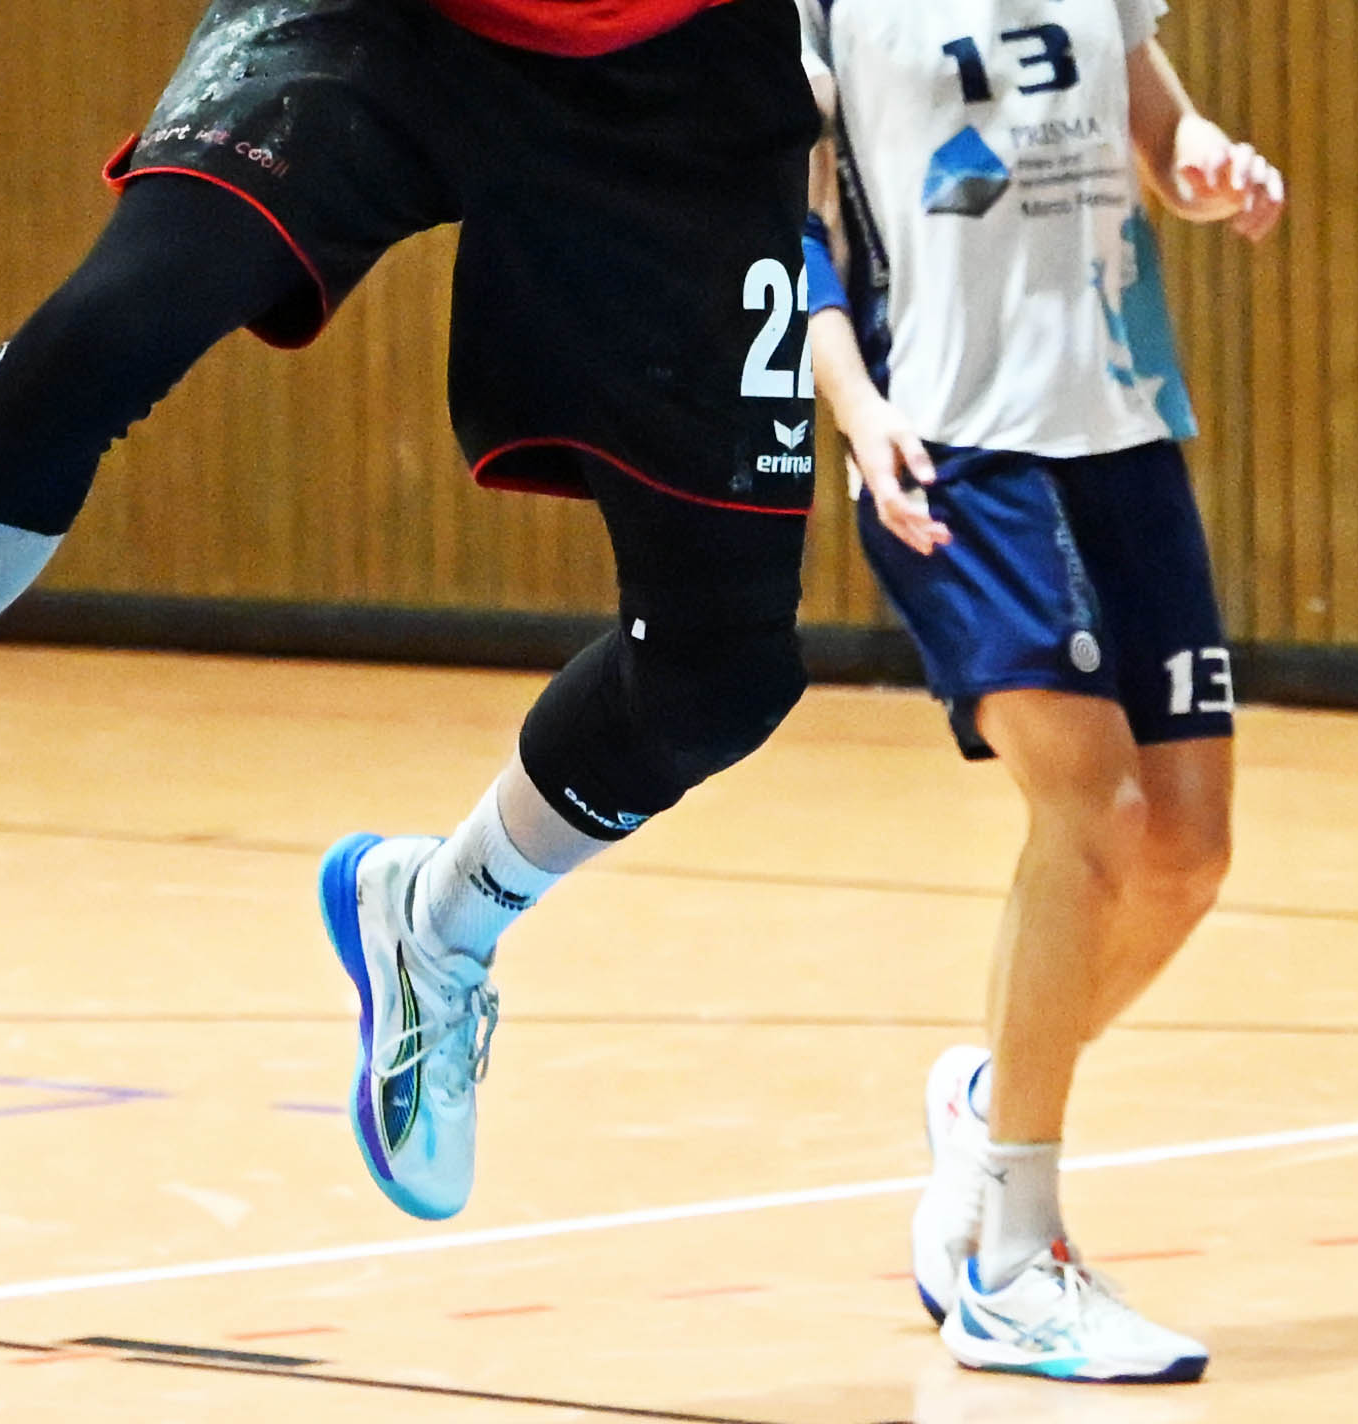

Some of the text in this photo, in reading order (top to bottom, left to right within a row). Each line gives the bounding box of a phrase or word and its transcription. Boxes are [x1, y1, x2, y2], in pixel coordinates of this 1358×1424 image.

[941, 22, 1081, 105] 13
[756, 451, 813, 475] erima
[1163, 646, 1235, 716] 13
